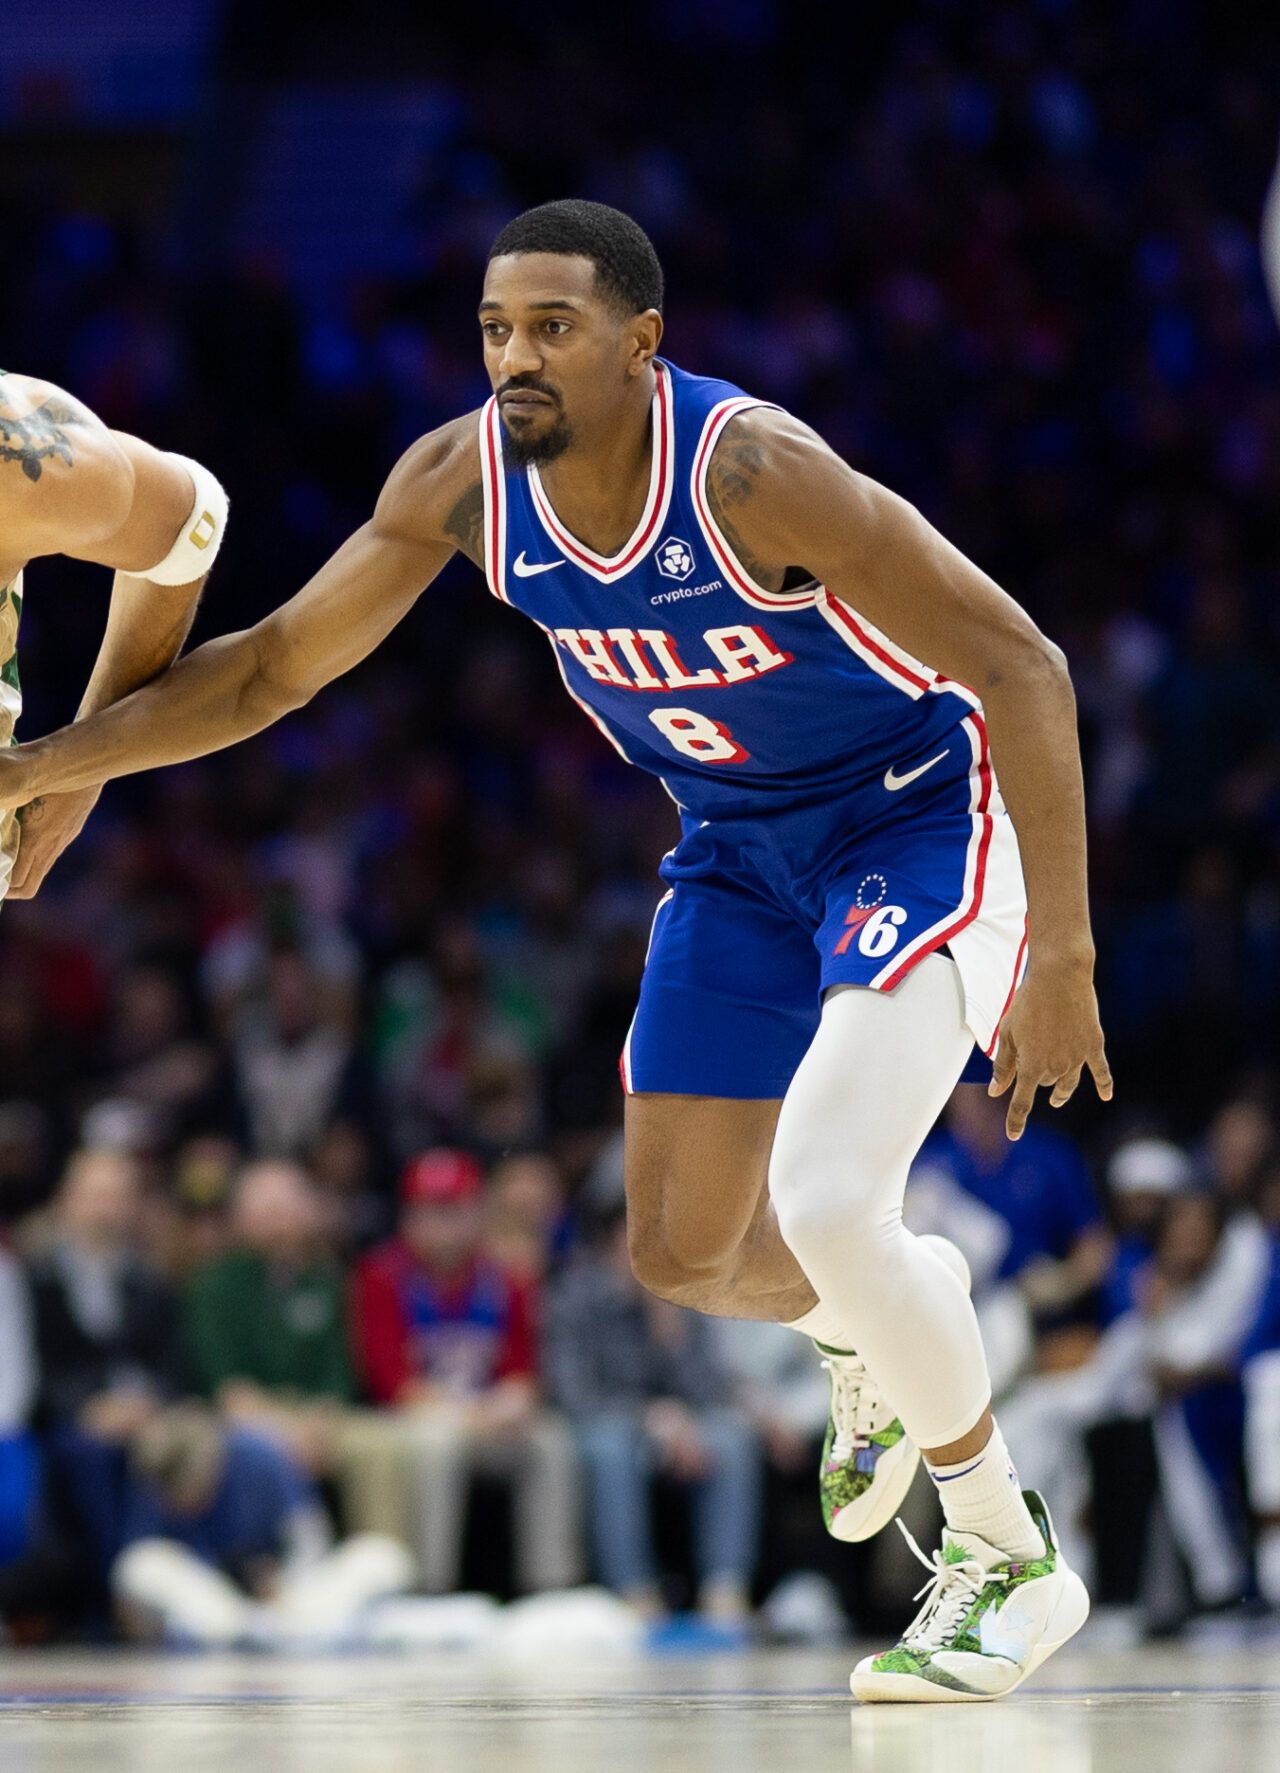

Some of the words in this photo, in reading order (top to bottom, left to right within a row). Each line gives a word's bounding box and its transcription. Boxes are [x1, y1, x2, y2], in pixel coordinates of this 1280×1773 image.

[650, 580, 722, 605] crypto.com
[648, 708, 750, 764] 8
[833, 904, 908, 957] 76
